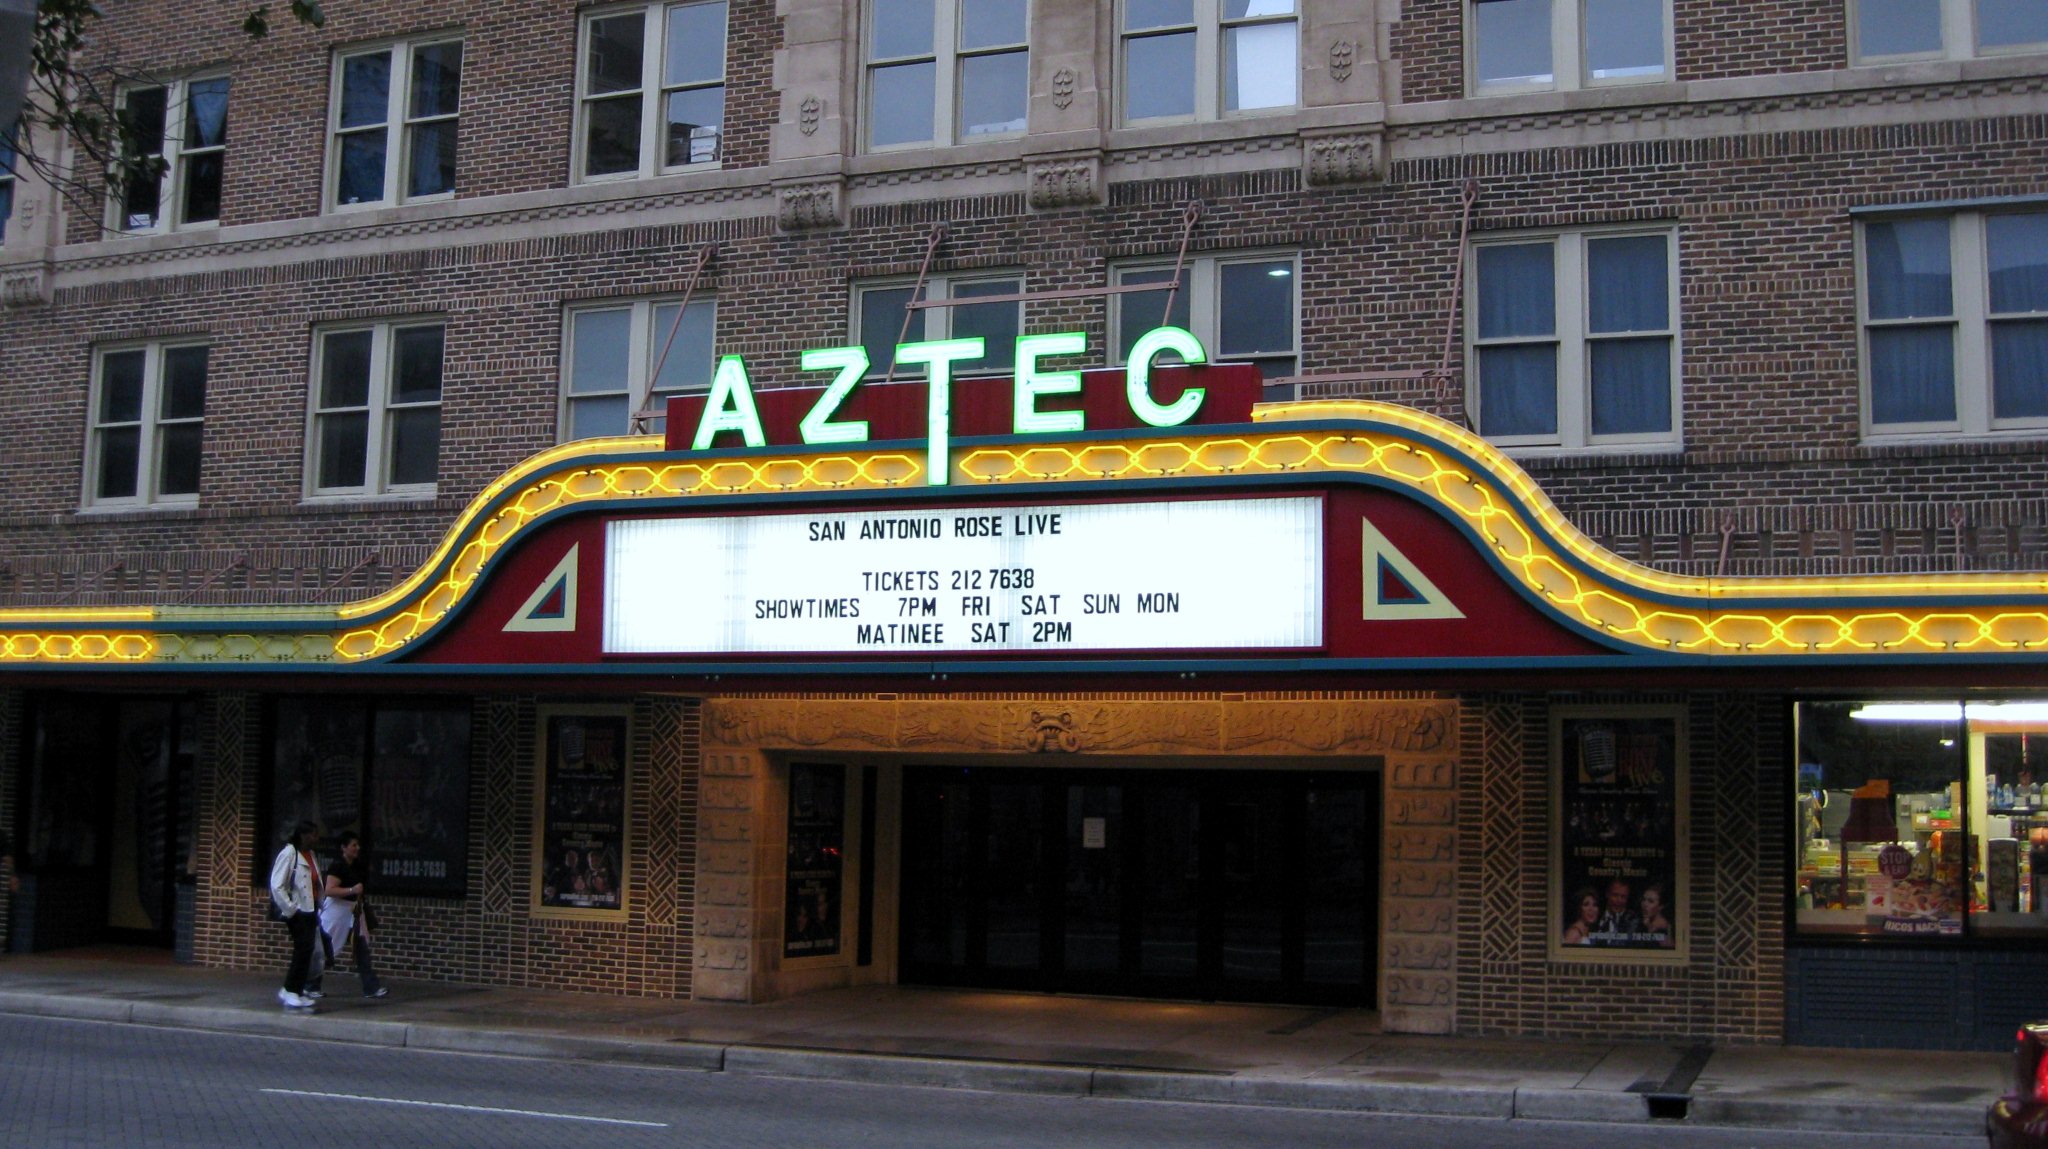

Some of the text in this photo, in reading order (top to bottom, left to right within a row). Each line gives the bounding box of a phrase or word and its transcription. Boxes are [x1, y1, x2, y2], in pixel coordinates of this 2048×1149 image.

[691, 326, 1206, 486] AZTEC
[809, 513, 1061, 542] SAN ANTONIO ROSE LIVE
[862, 568, 1034, 591] TICKETS 212 7638
[755, 592, 1179, 619] SHOWTIMES 7PM FRI SAT SUN MON
[857, 621, 1072, 644] MATINEE SAT 2PM
[1881, 851, 1910, 865] STOP
